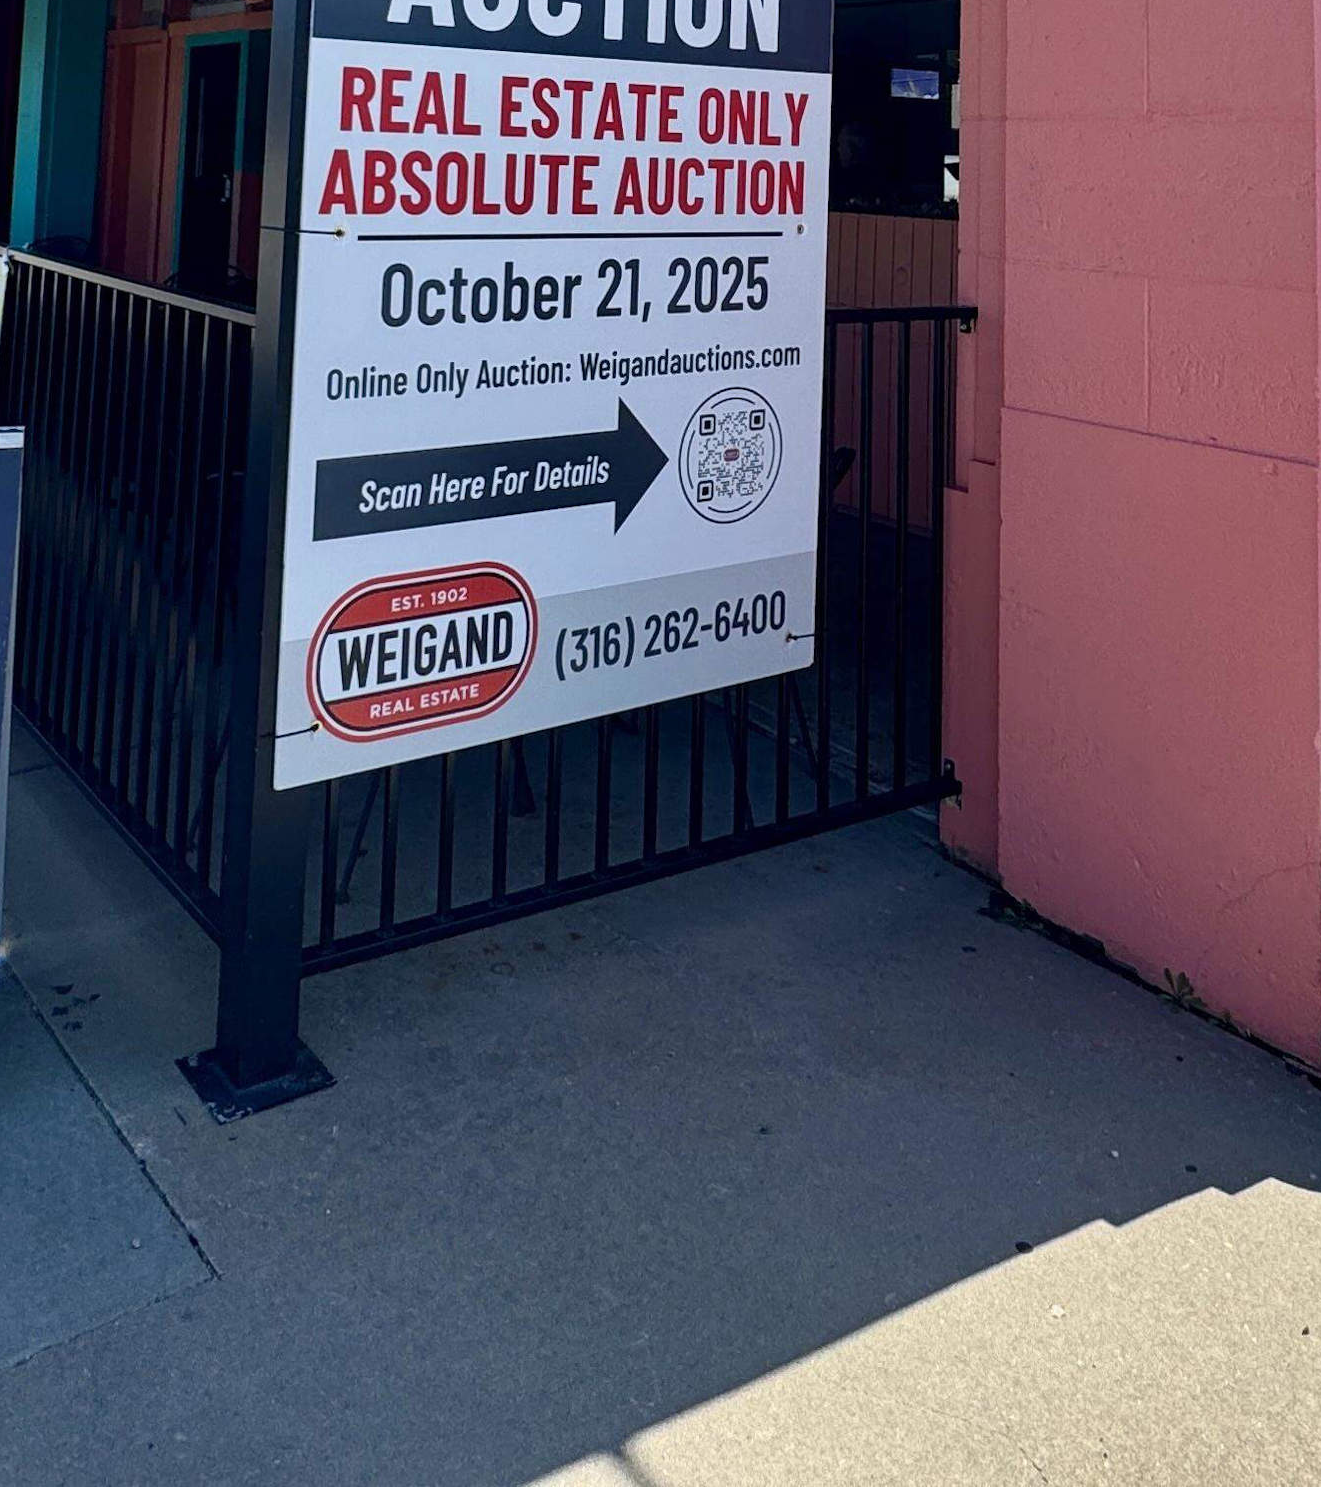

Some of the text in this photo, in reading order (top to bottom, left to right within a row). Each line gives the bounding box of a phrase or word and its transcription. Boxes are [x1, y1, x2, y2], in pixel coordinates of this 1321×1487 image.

[339, 65, 810, 146] REAL ESTATE ONLY
[318, 147, 805, 216] ABSOLUTE AUCTION
[380, 255, 770, 328] October 21, 2025
[326, 344, 801, 400] Online Only Auction: Weigandauctions.com
[358, 455, 611, 513] Scan Here For Details
[390, 586, 469, 613] EST. 1902
[337, 609, 514, 692] WEIGAND
[554, 590, 786, 681] (316) 262-6400
[369, 684, 481, 720] REAL ESTATE
